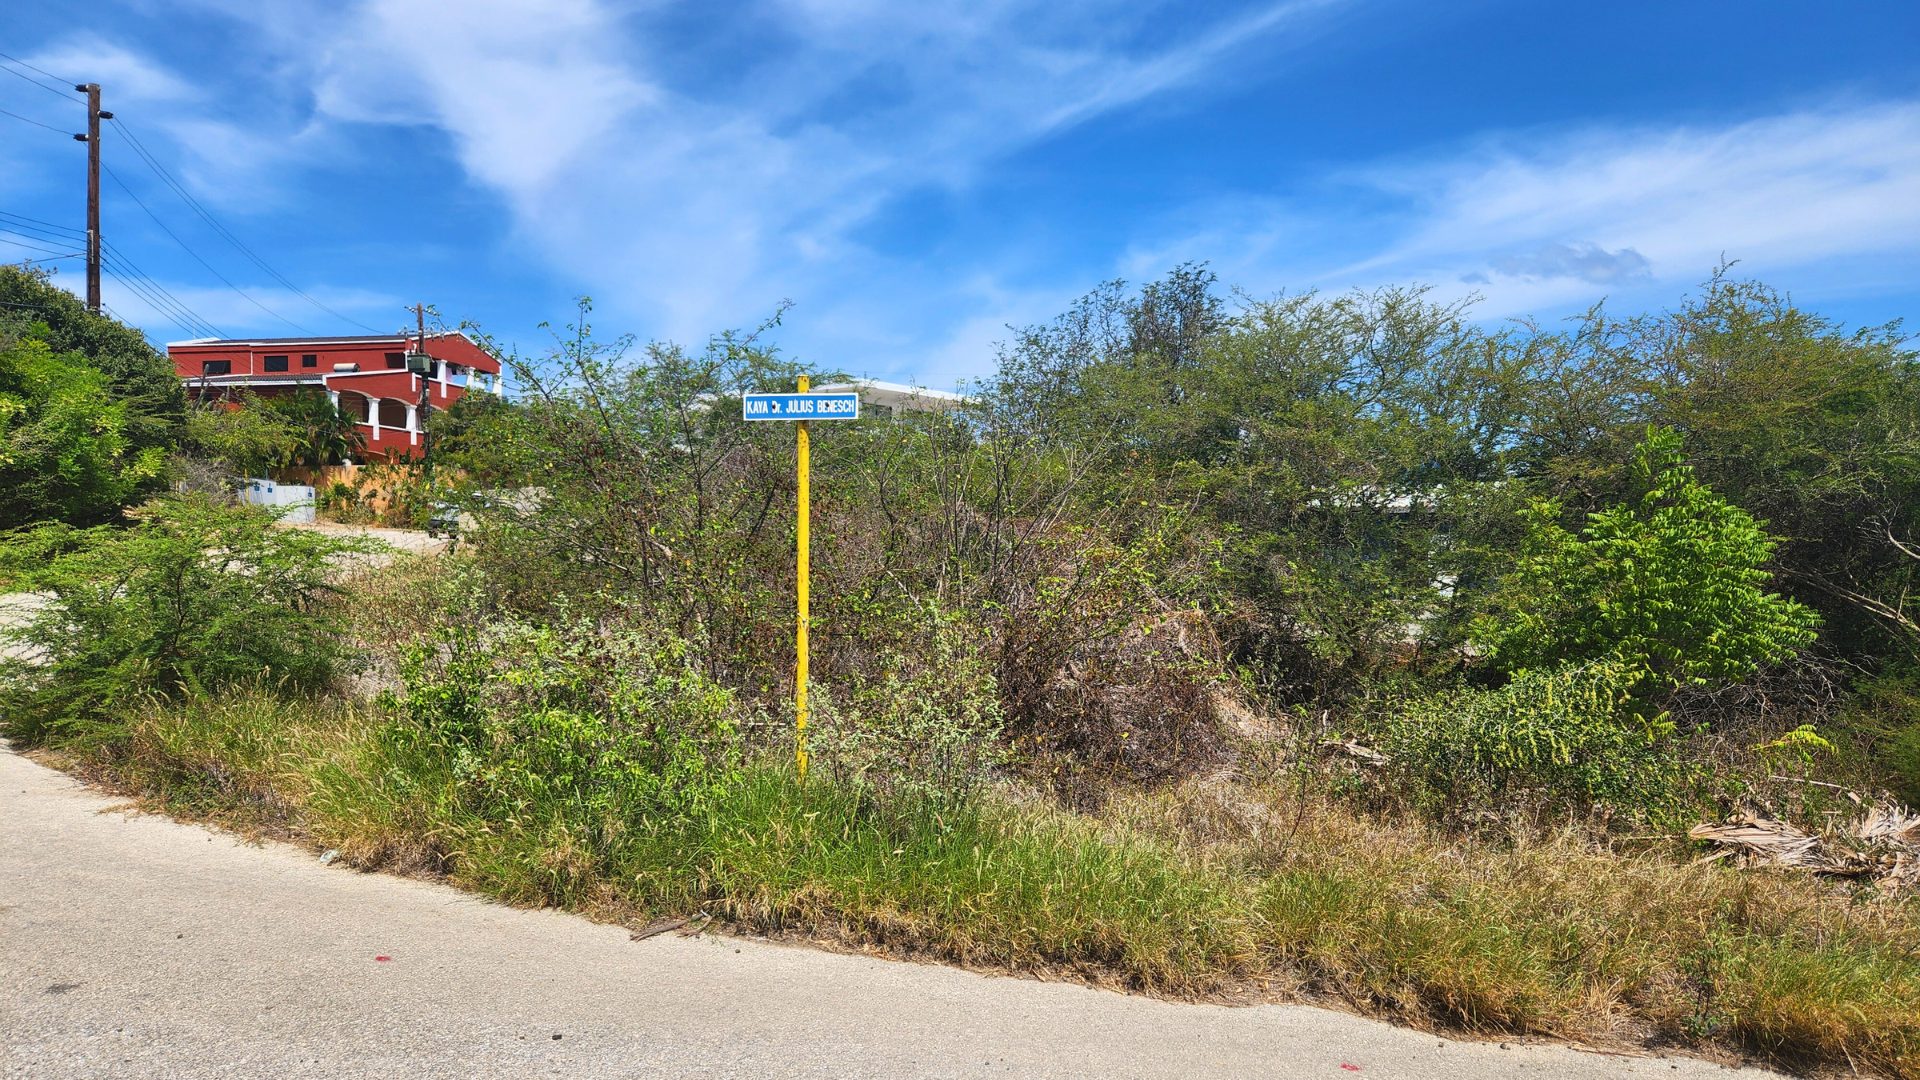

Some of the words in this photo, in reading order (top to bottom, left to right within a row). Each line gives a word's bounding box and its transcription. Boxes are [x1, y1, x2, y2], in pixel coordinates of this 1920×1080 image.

[747, 401, 768, 414] KAYA
[772, 401, 782, 414] Dr.
[786, 400, 813, 413] JULIUS
[817, 400, 854, 413] BENESCH
